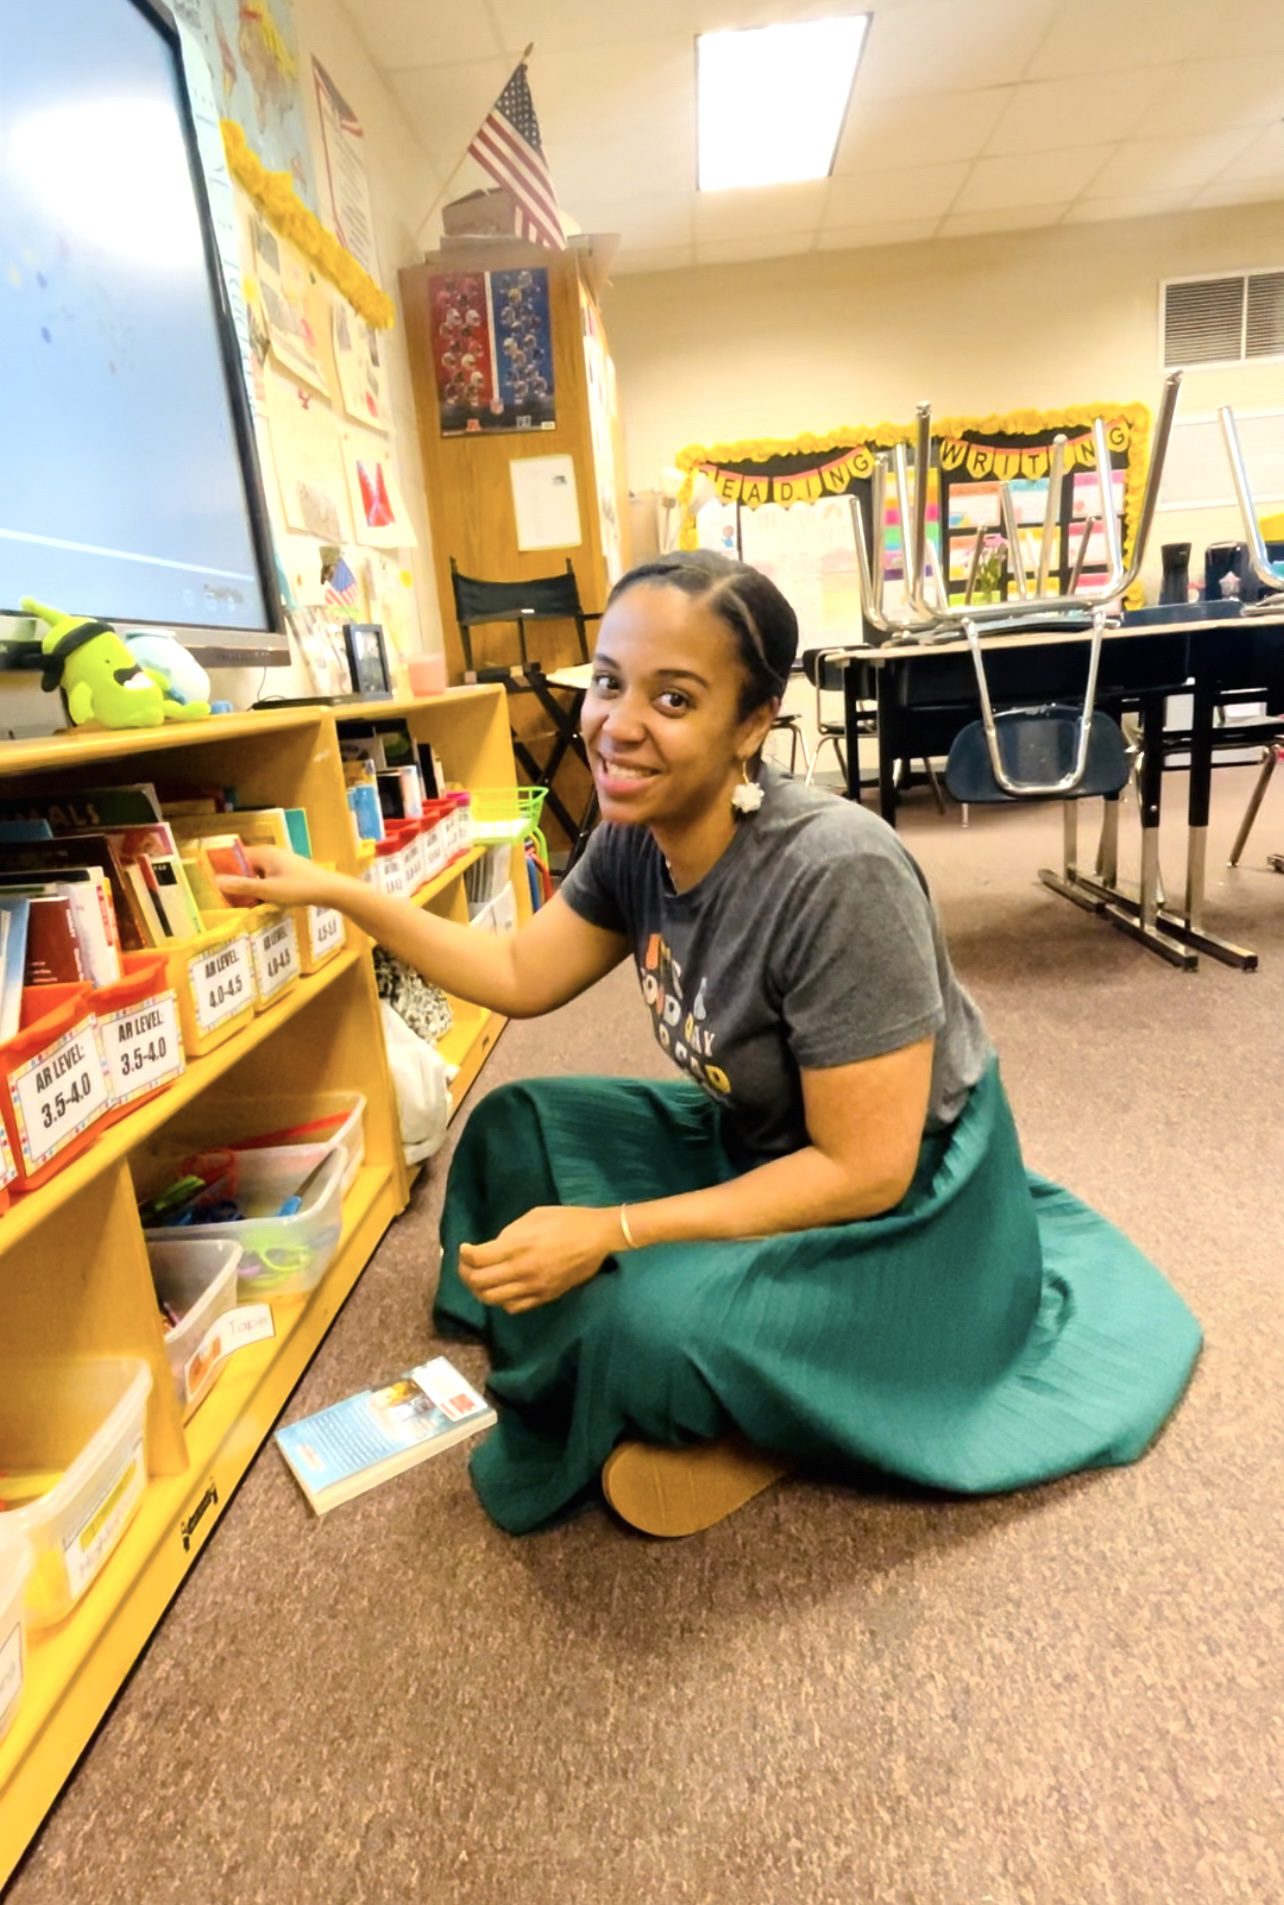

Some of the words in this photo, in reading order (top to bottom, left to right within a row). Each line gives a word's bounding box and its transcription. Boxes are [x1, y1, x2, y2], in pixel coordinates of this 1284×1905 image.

[942, 427, 1125, 474] WRITNG
[699, 454, 869, 502] EADING
[205, 959, 216, 979] AR
[209, 974, 242, 1008] 4.0-4.5
[118, 1021, 133, 1043] AR
[120, 1036, 167, 1076] 3.5-4.0
[35, 1065, 53, 1094] AR
[41, 1071, 91, 1129] 3.5-4.0
